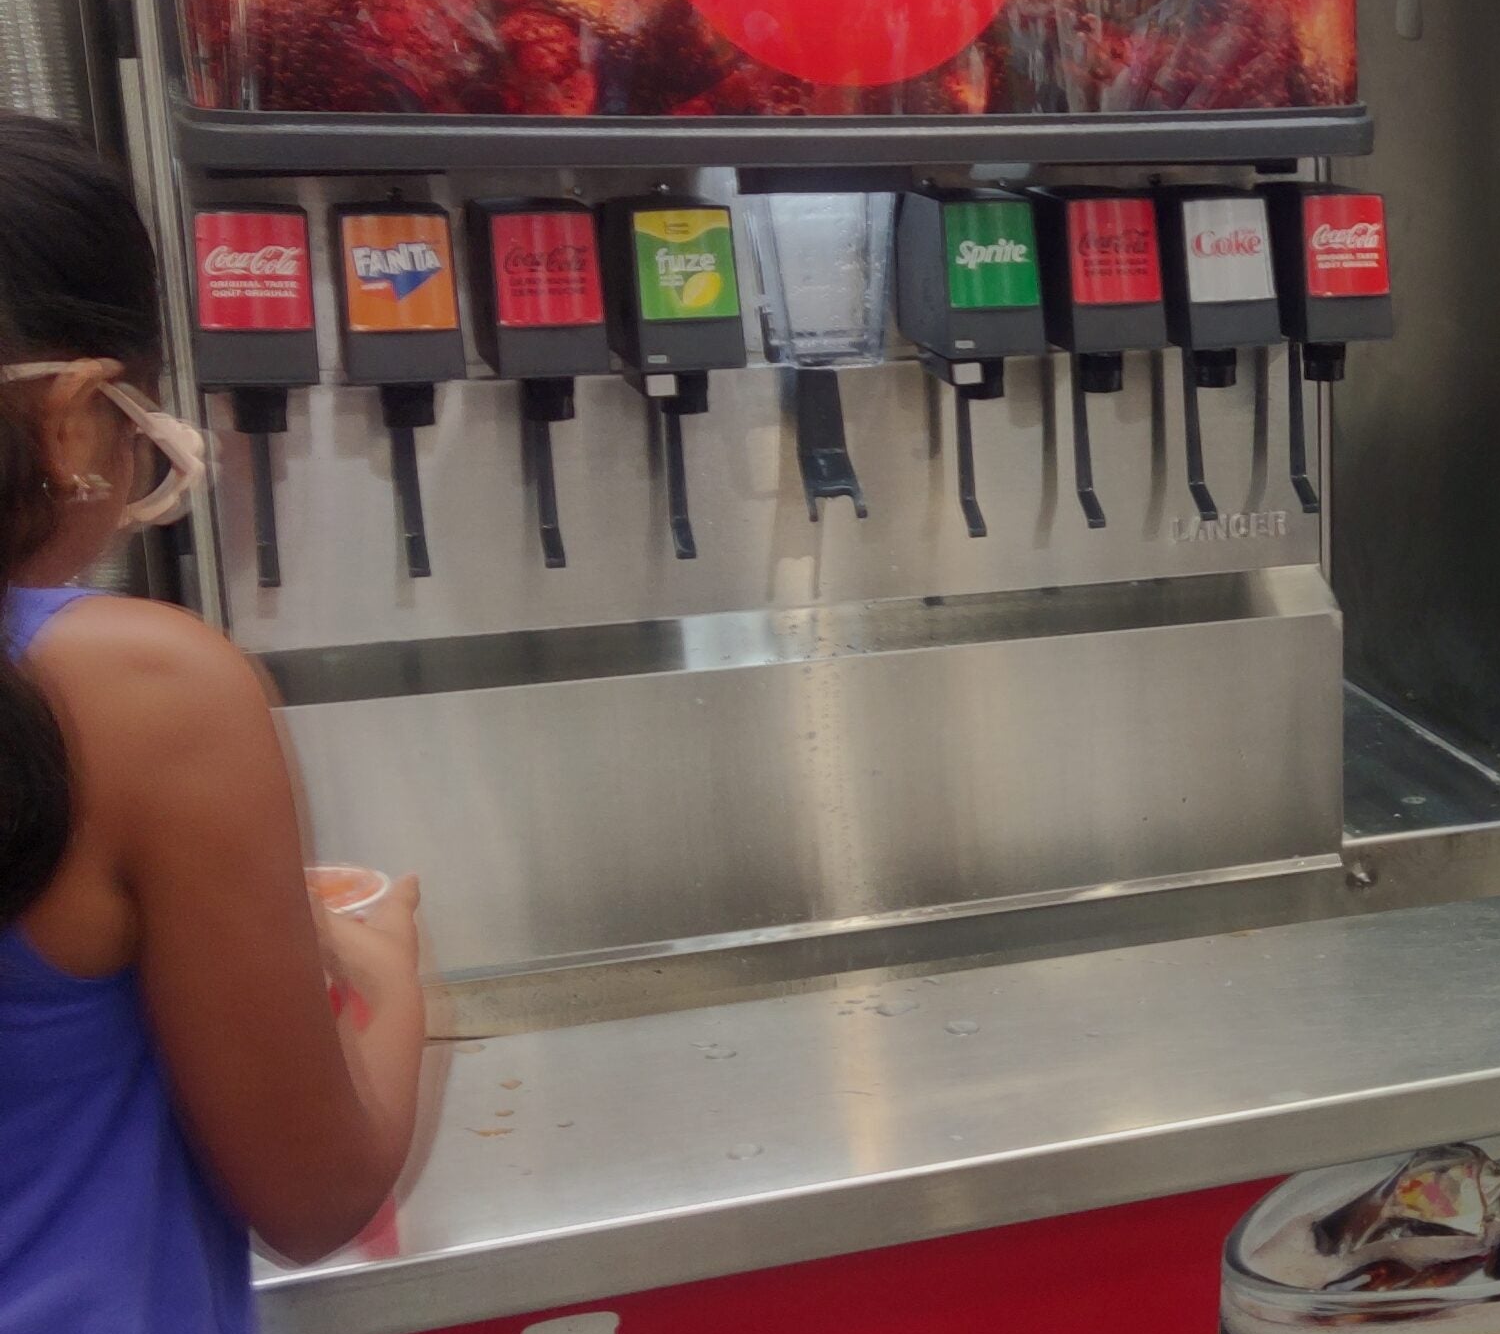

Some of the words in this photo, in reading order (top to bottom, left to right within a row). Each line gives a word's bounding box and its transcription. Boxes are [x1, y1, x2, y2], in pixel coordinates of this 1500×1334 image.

[352, 243, 442, 277] FANTA
[655, 247, 716, 274] fuze
[955, 238, 1031, 269] Sprite
